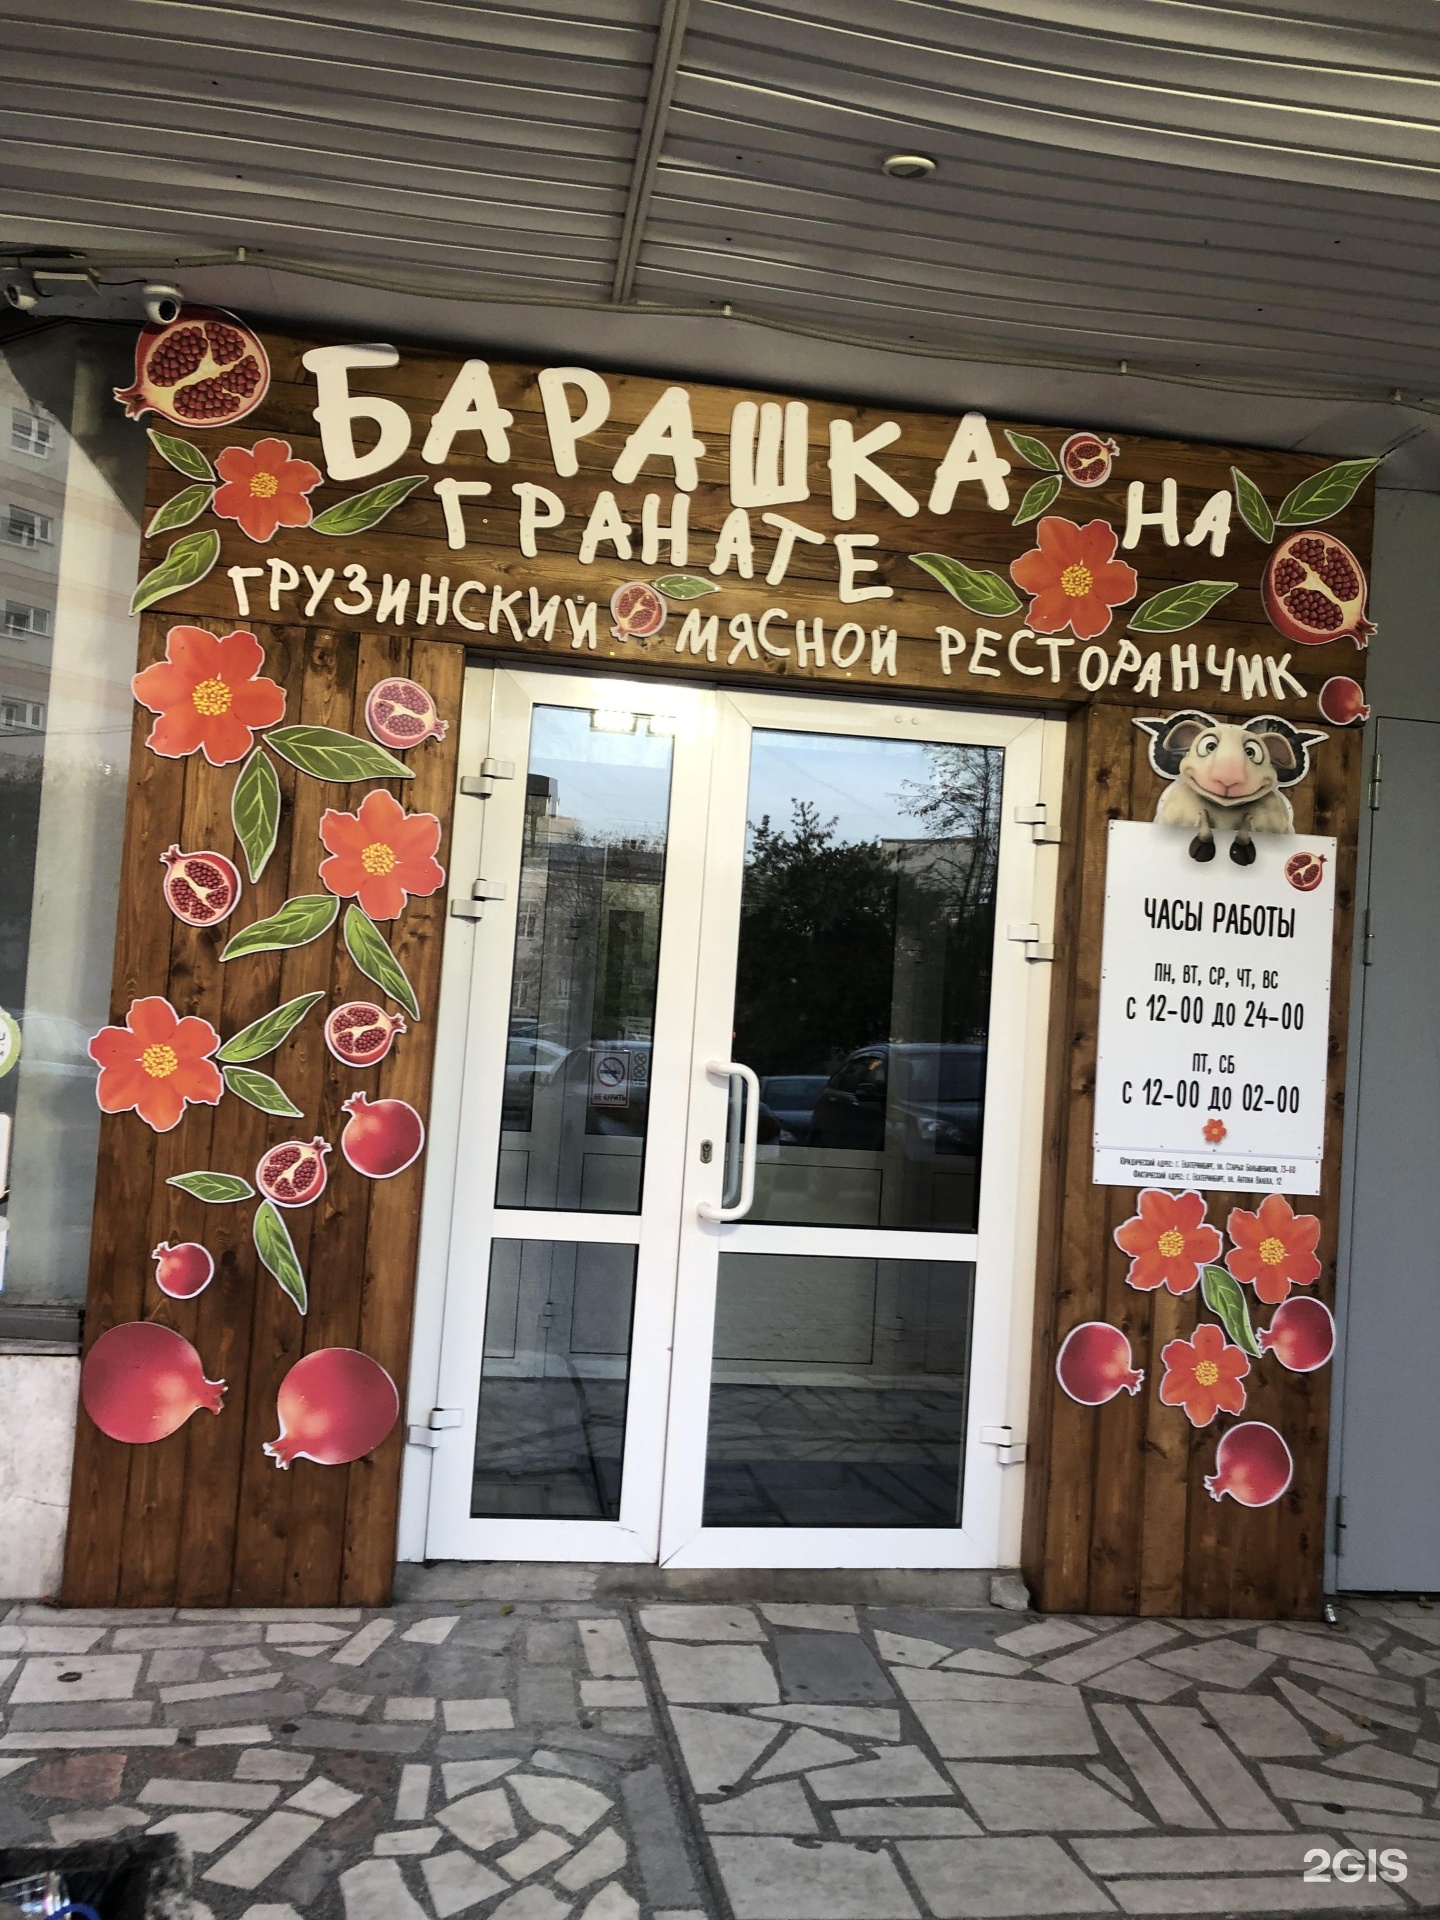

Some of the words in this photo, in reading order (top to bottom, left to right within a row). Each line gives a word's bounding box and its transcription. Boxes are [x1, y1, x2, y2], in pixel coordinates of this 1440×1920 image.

[302, 345, 1012, 521] БАРАШКА
[1122, 477, 1233, 558] НА
[433, 477, 894, 604] ГРАНАТЕ
[227, 557, 598, 650] ГРУЗИНСКИЙ
[675, 608, 898, 677] МЯСНОЙ
[935, 625, 1308, 701] РЕСТОРАНЧИК
[1144, 897, 1203, 932] ЧАСЫ
[1212, 902, 1296, 939] РАБОТЫ
[1154, 962, 1176, 985] ПН,
[1182, 964, 1202, 987] ВТ,
[1208, 966, 1230, 989] СР,
[1236, 968, 1256, 990] ЧТ,
[1262, 970, 1279, 990] ВС
[1146, 993, 1204, 1025] 12-00
[1243, 1000, 1304, 1031] 24-00
[1192, 1052, 1212, 1075] ПТ,
[1219, 1054, 1235, 1074] СБ
[593, 1093, 602, 1101] НЕ
[603, 1093, 626, 1102] КУРИТЬ
[1142, 1077, 1200, 1109] 12-00
[1242, 1083, 1300, 1114] 02-00
